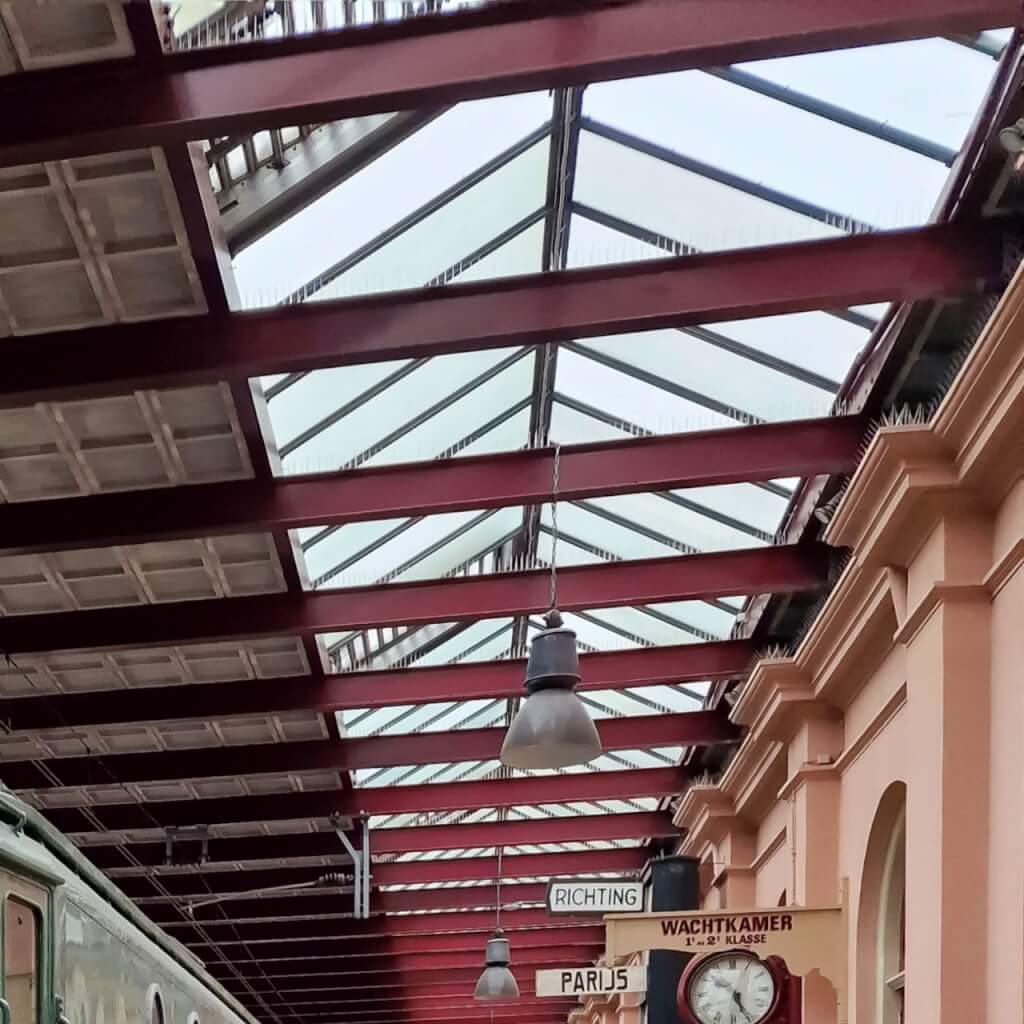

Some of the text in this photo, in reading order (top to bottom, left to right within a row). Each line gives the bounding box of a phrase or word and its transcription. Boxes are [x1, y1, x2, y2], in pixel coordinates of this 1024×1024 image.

[555, 887, 638, 906] RICHTING
[661, 915, 793, 936] WACHTKAMER
[725, 934, 767, 945] KLASSE
[561, 968, 629, 993] PARIJS
